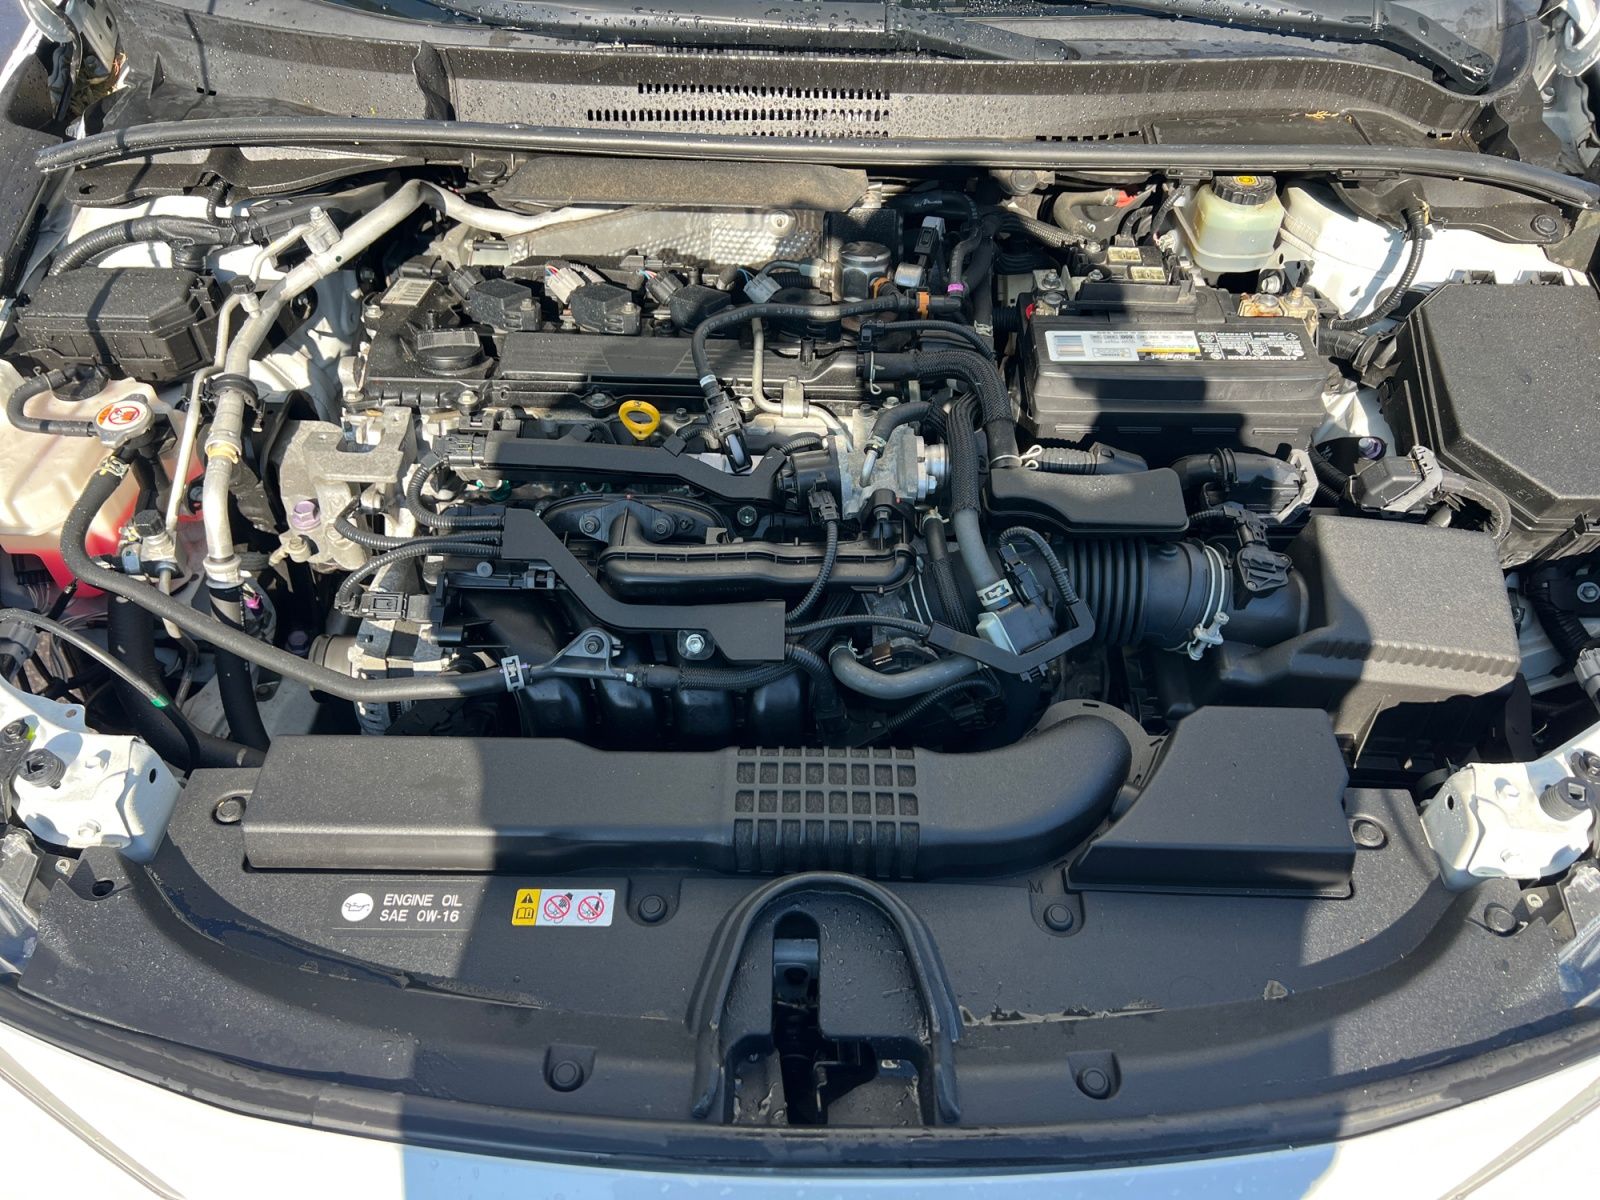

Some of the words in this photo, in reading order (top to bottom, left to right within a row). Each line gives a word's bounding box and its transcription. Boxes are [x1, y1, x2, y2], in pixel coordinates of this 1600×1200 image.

[383, 893, 435, 907] ENGINE
[441, 894, 463, 907] OIL
[379, 908, 409, 922] SAE
